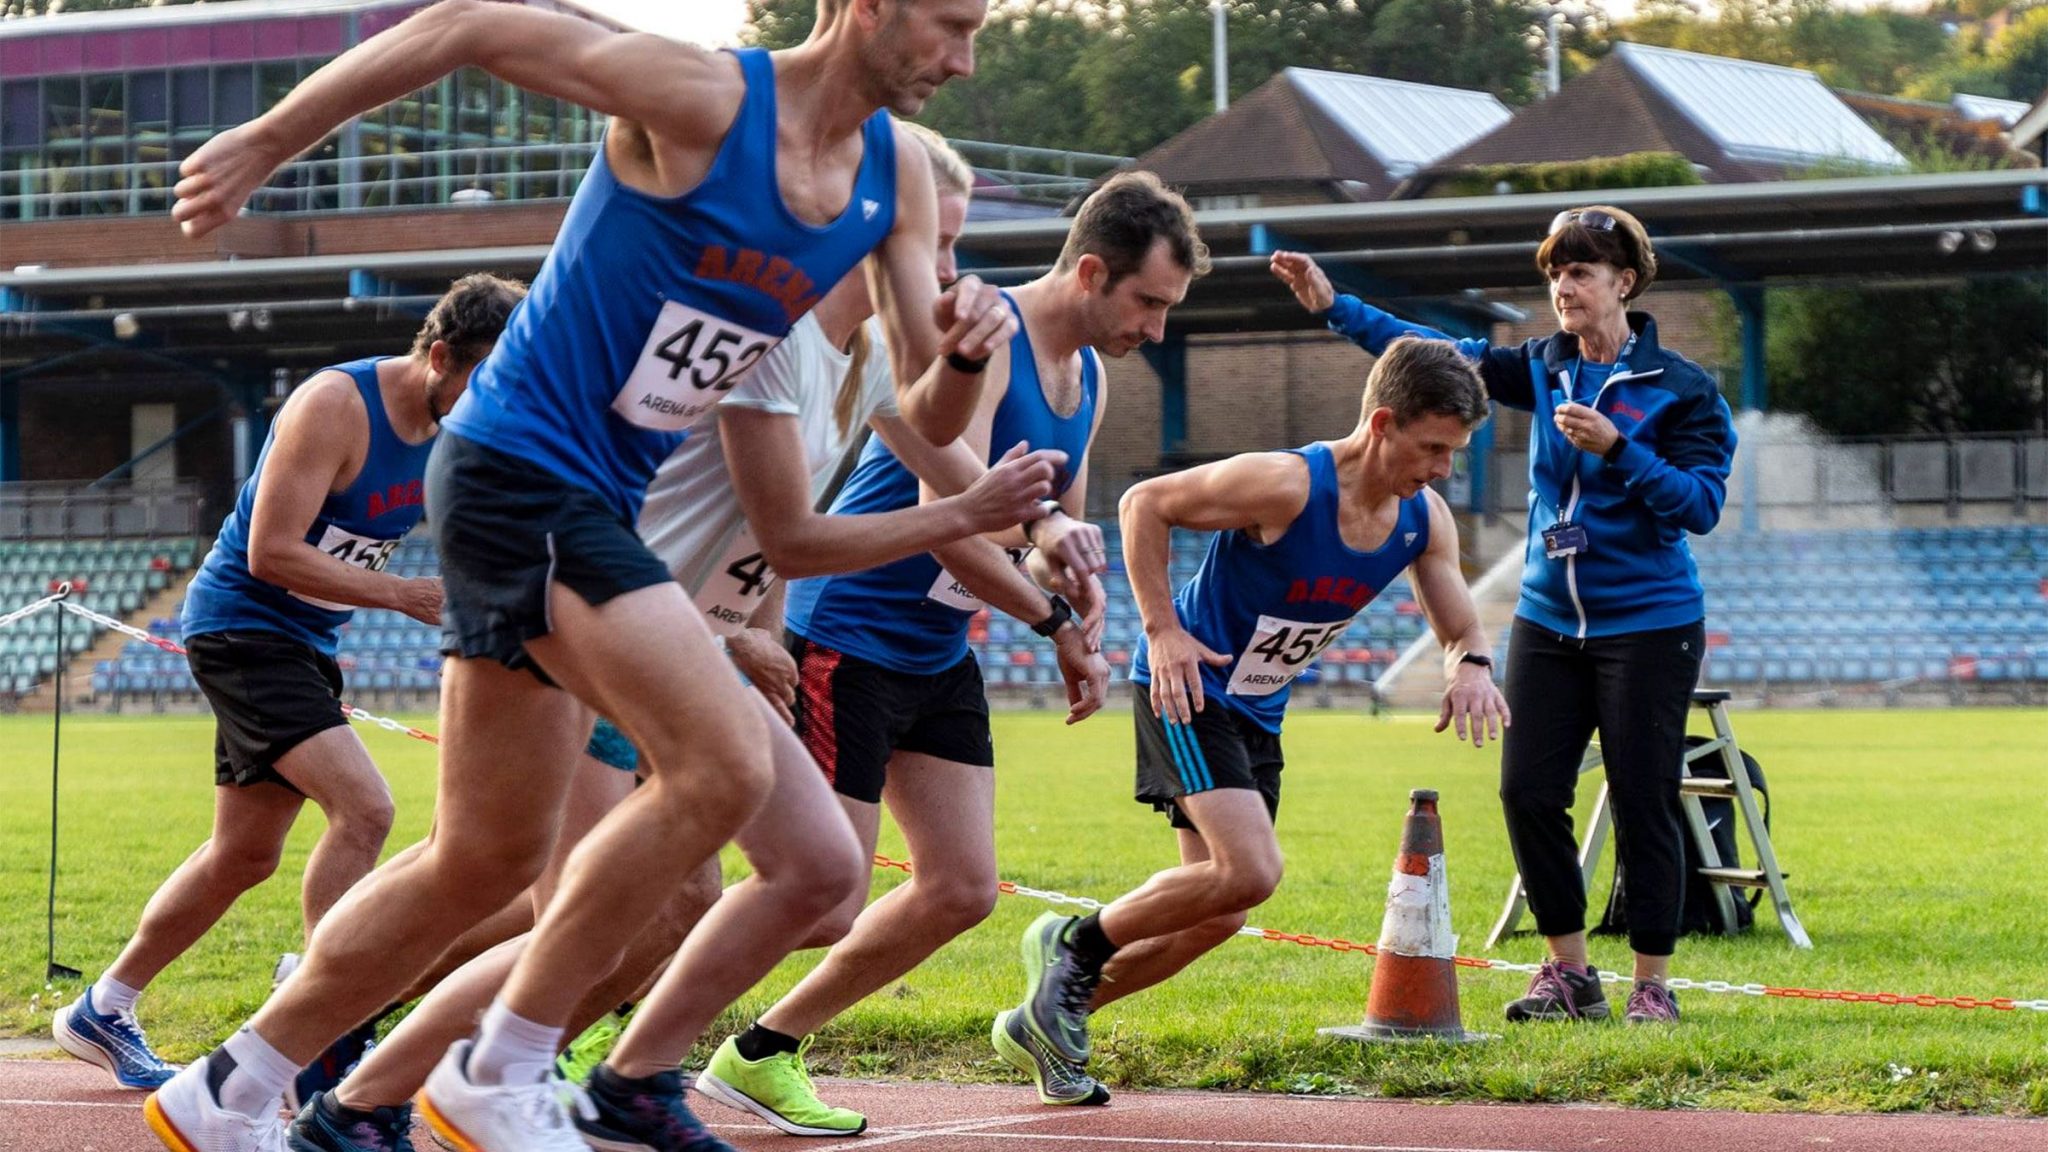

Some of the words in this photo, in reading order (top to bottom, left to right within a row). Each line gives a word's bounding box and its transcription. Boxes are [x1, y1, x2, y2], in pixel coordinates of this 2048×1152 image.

[654, 319, 768, 391] 452
[638, 392, 686, 417] ARENA
[1242, 674, 1284, 684] ARENA
